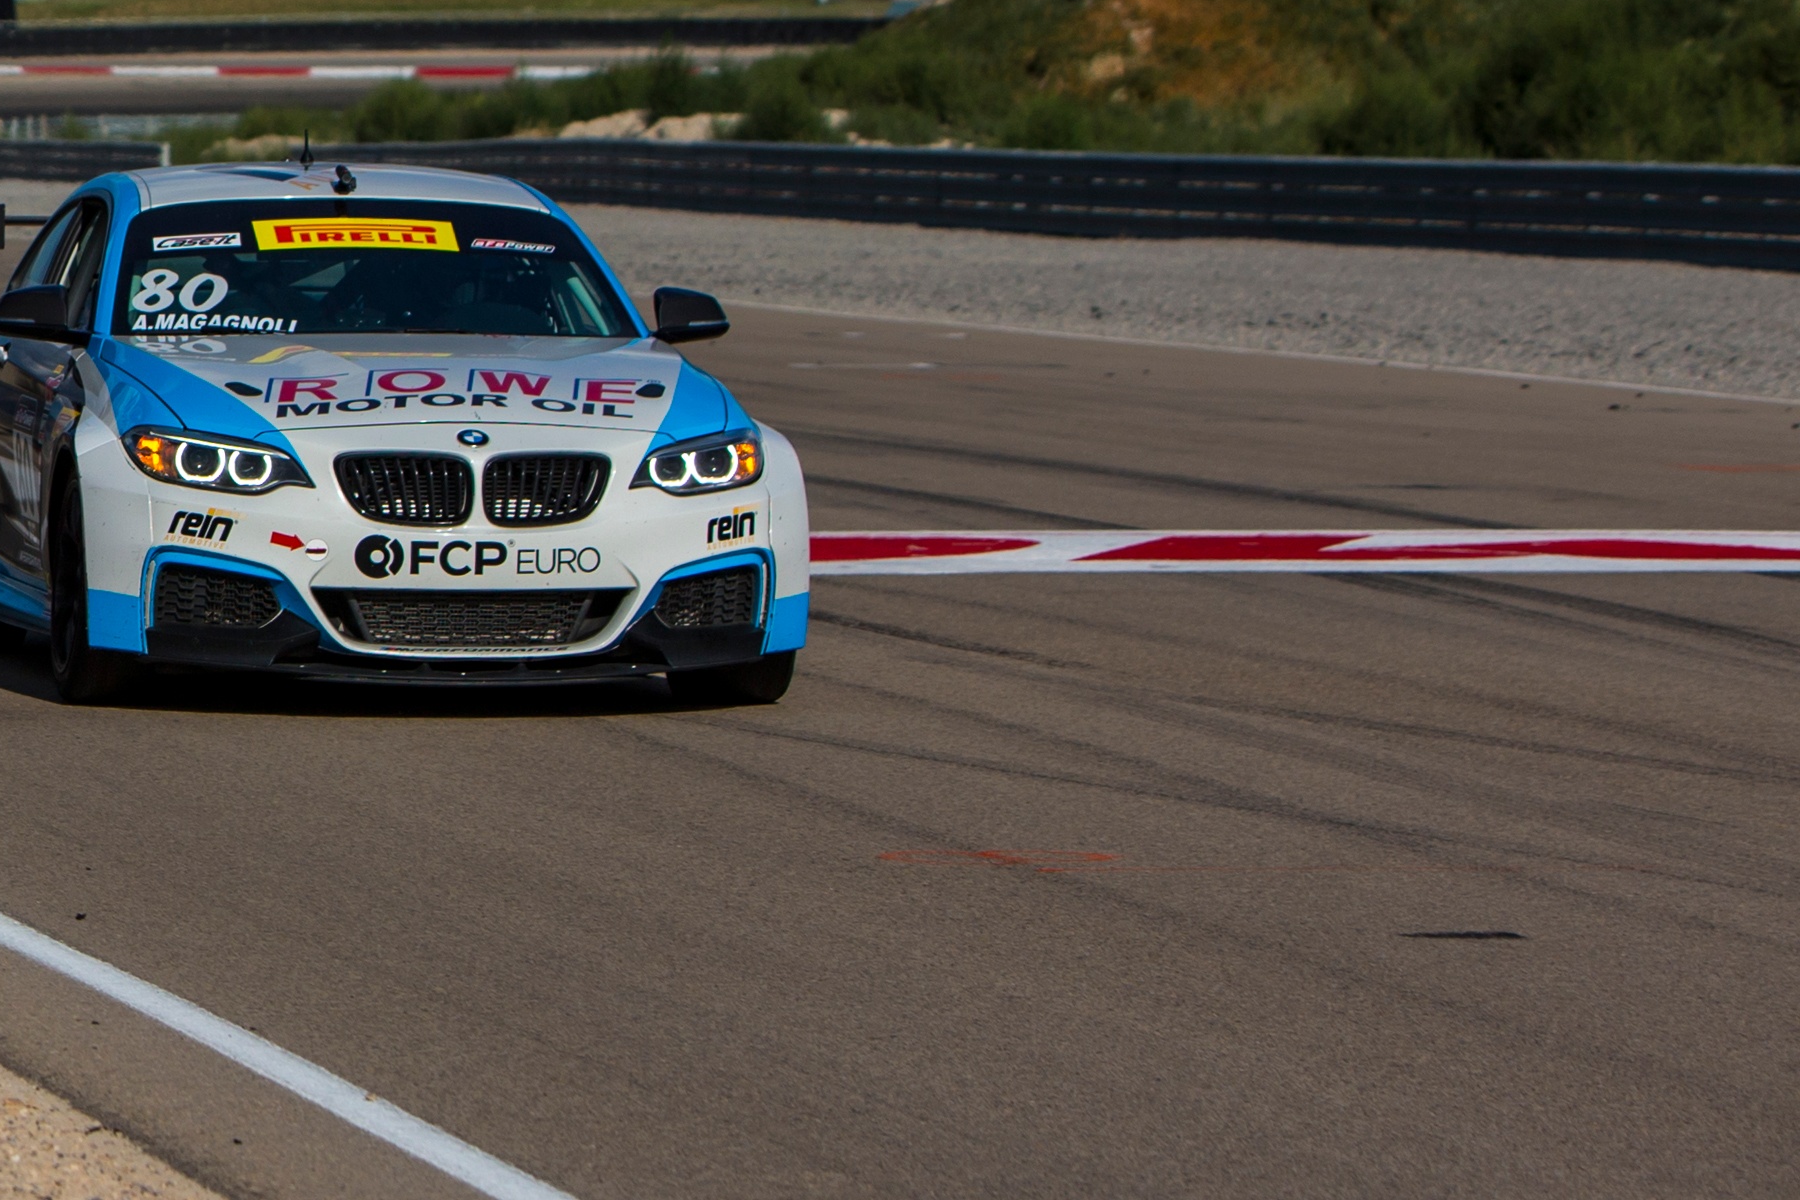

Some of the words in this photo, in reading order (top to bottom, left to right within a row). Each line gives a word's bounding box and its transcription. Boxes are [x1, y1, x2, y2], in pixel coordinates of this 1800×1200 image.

[273, 224, 437, 245] PIRELLI
[131, 269, 229, 313] 80
[266, 369, 638, 404] ROWE
[275, 393, 508, 419] MOTOR
[531, 399, 634, 419] OIL
[163, 531, 227, 551] AUTOMOTIVE
[167, 507, 235, 543] rein
[707, 506, 756, 544] rein
[409, 540, 508, 577] FCP
[515, 546, 602, 575] EURO
